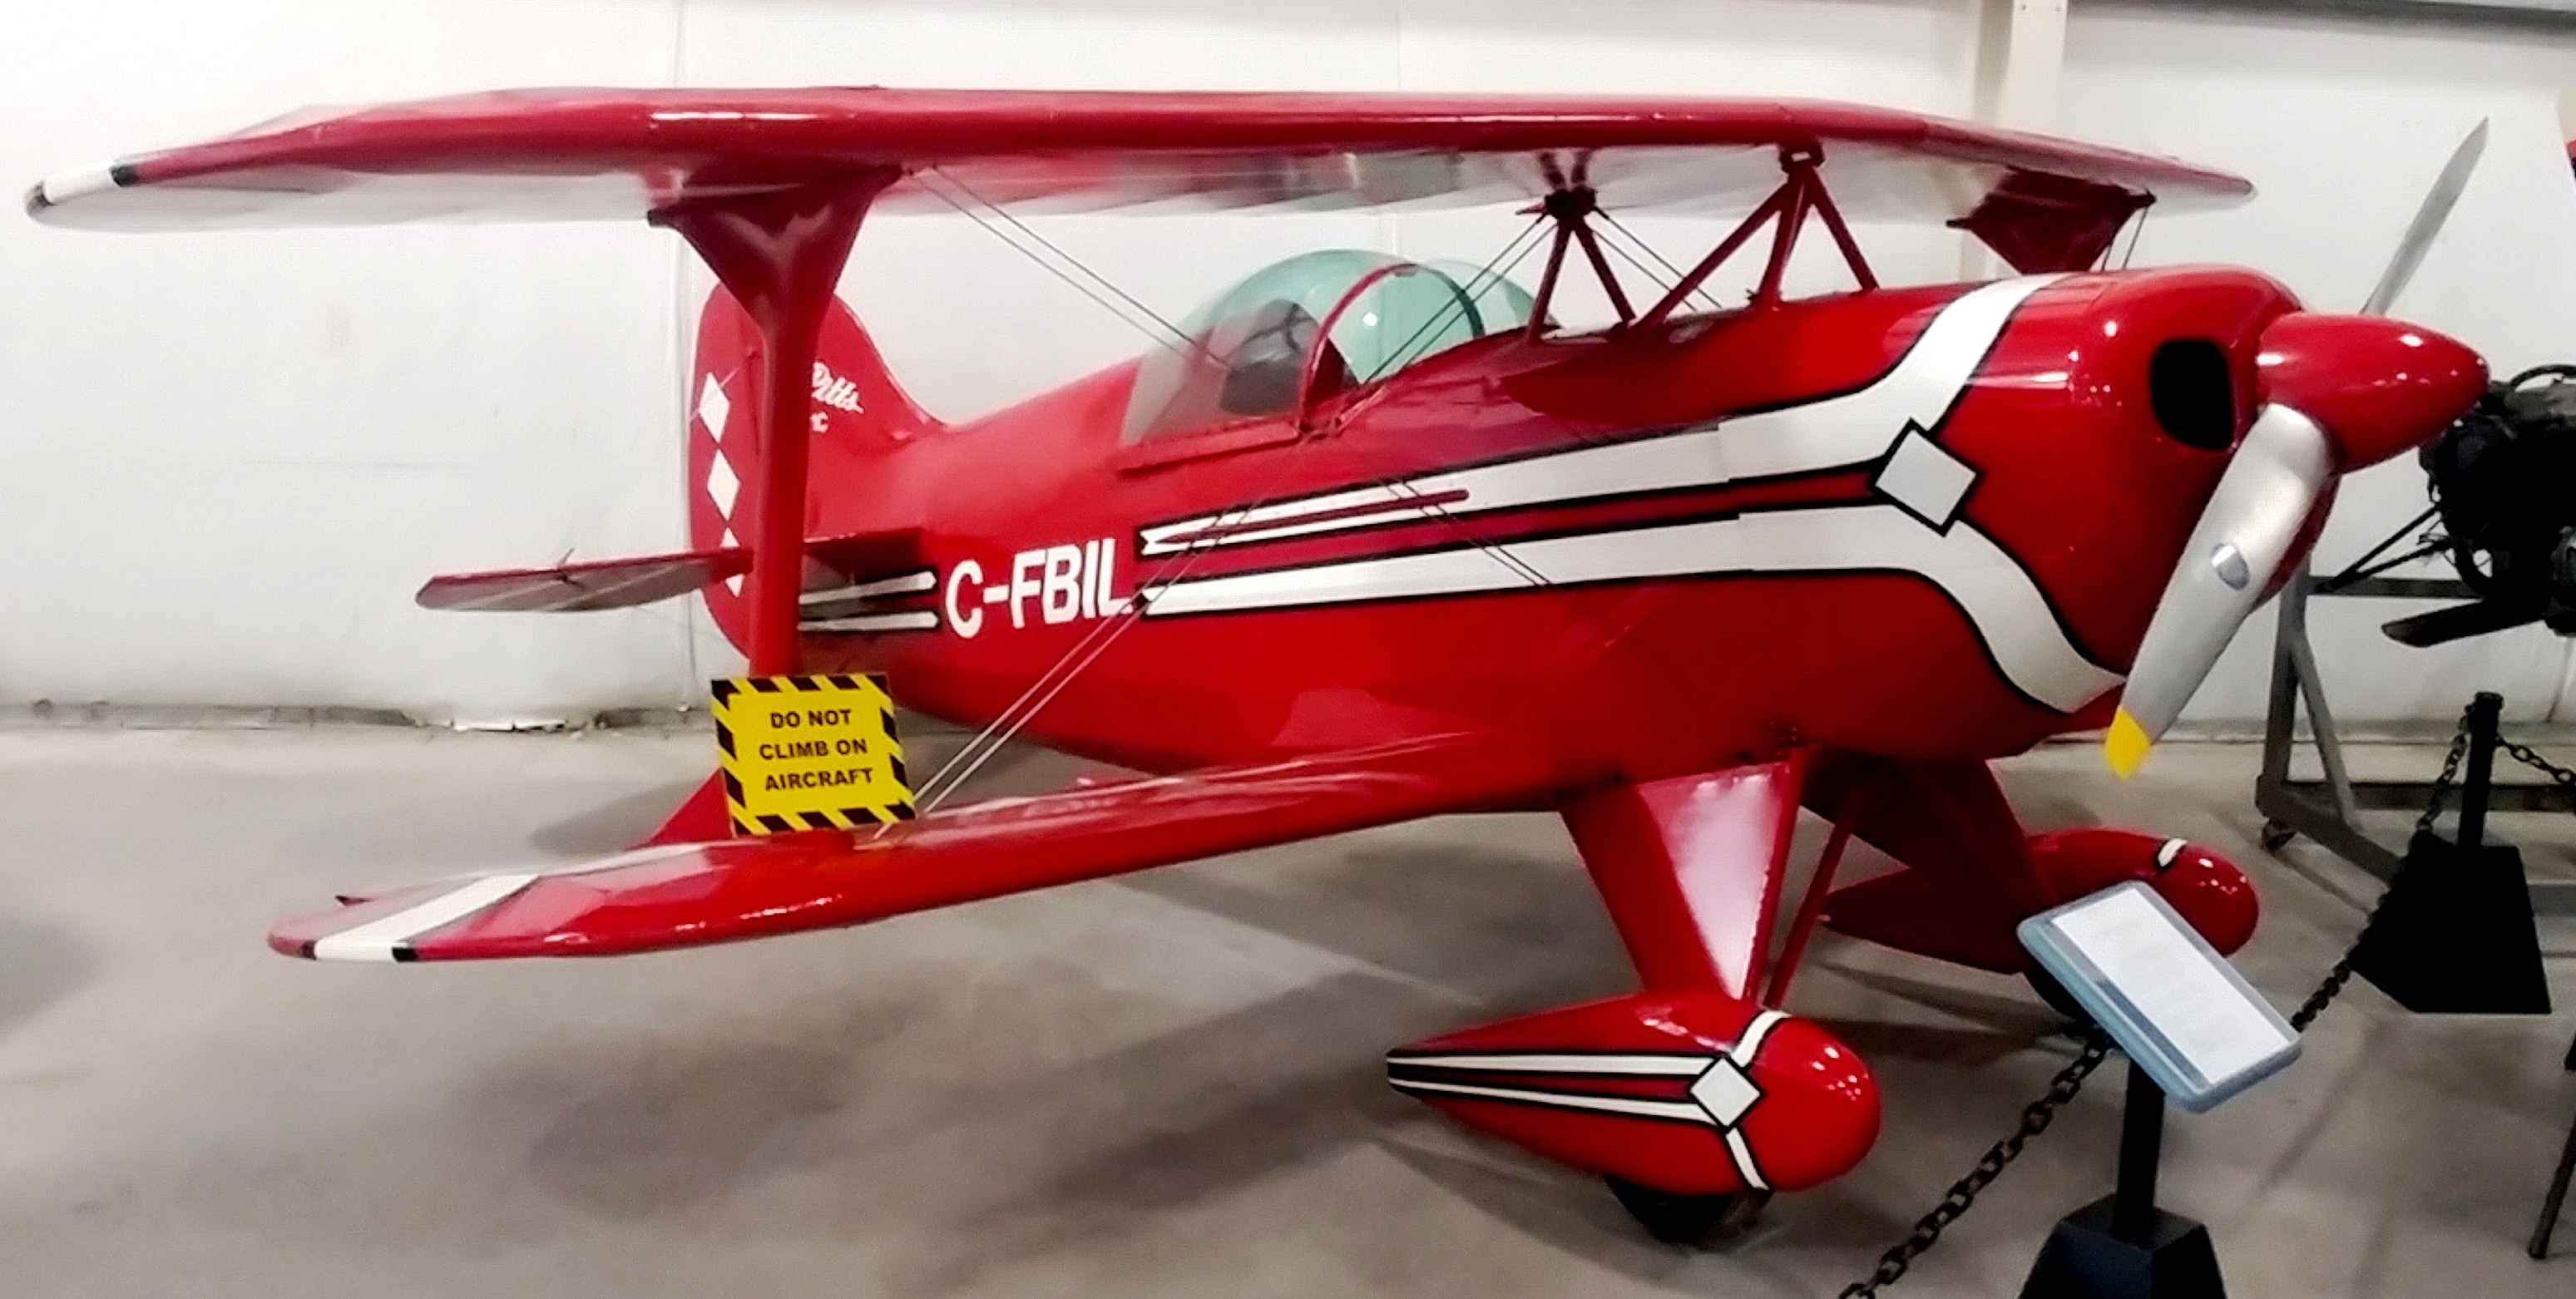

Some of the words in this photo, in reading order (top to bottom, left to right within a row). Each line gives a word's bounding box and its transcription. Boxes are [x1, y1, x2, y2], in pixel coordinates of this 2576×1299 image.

[946, 538, 1133, 639] C-FBIL
[771, 711, 800, 729] DO
[808, 709, 851, 727] NOT
[759, 740, 828, 760] CLIMB
[836, 738, 868, 755] ON
[765, 768, 873, 791] AIRCRAFT
